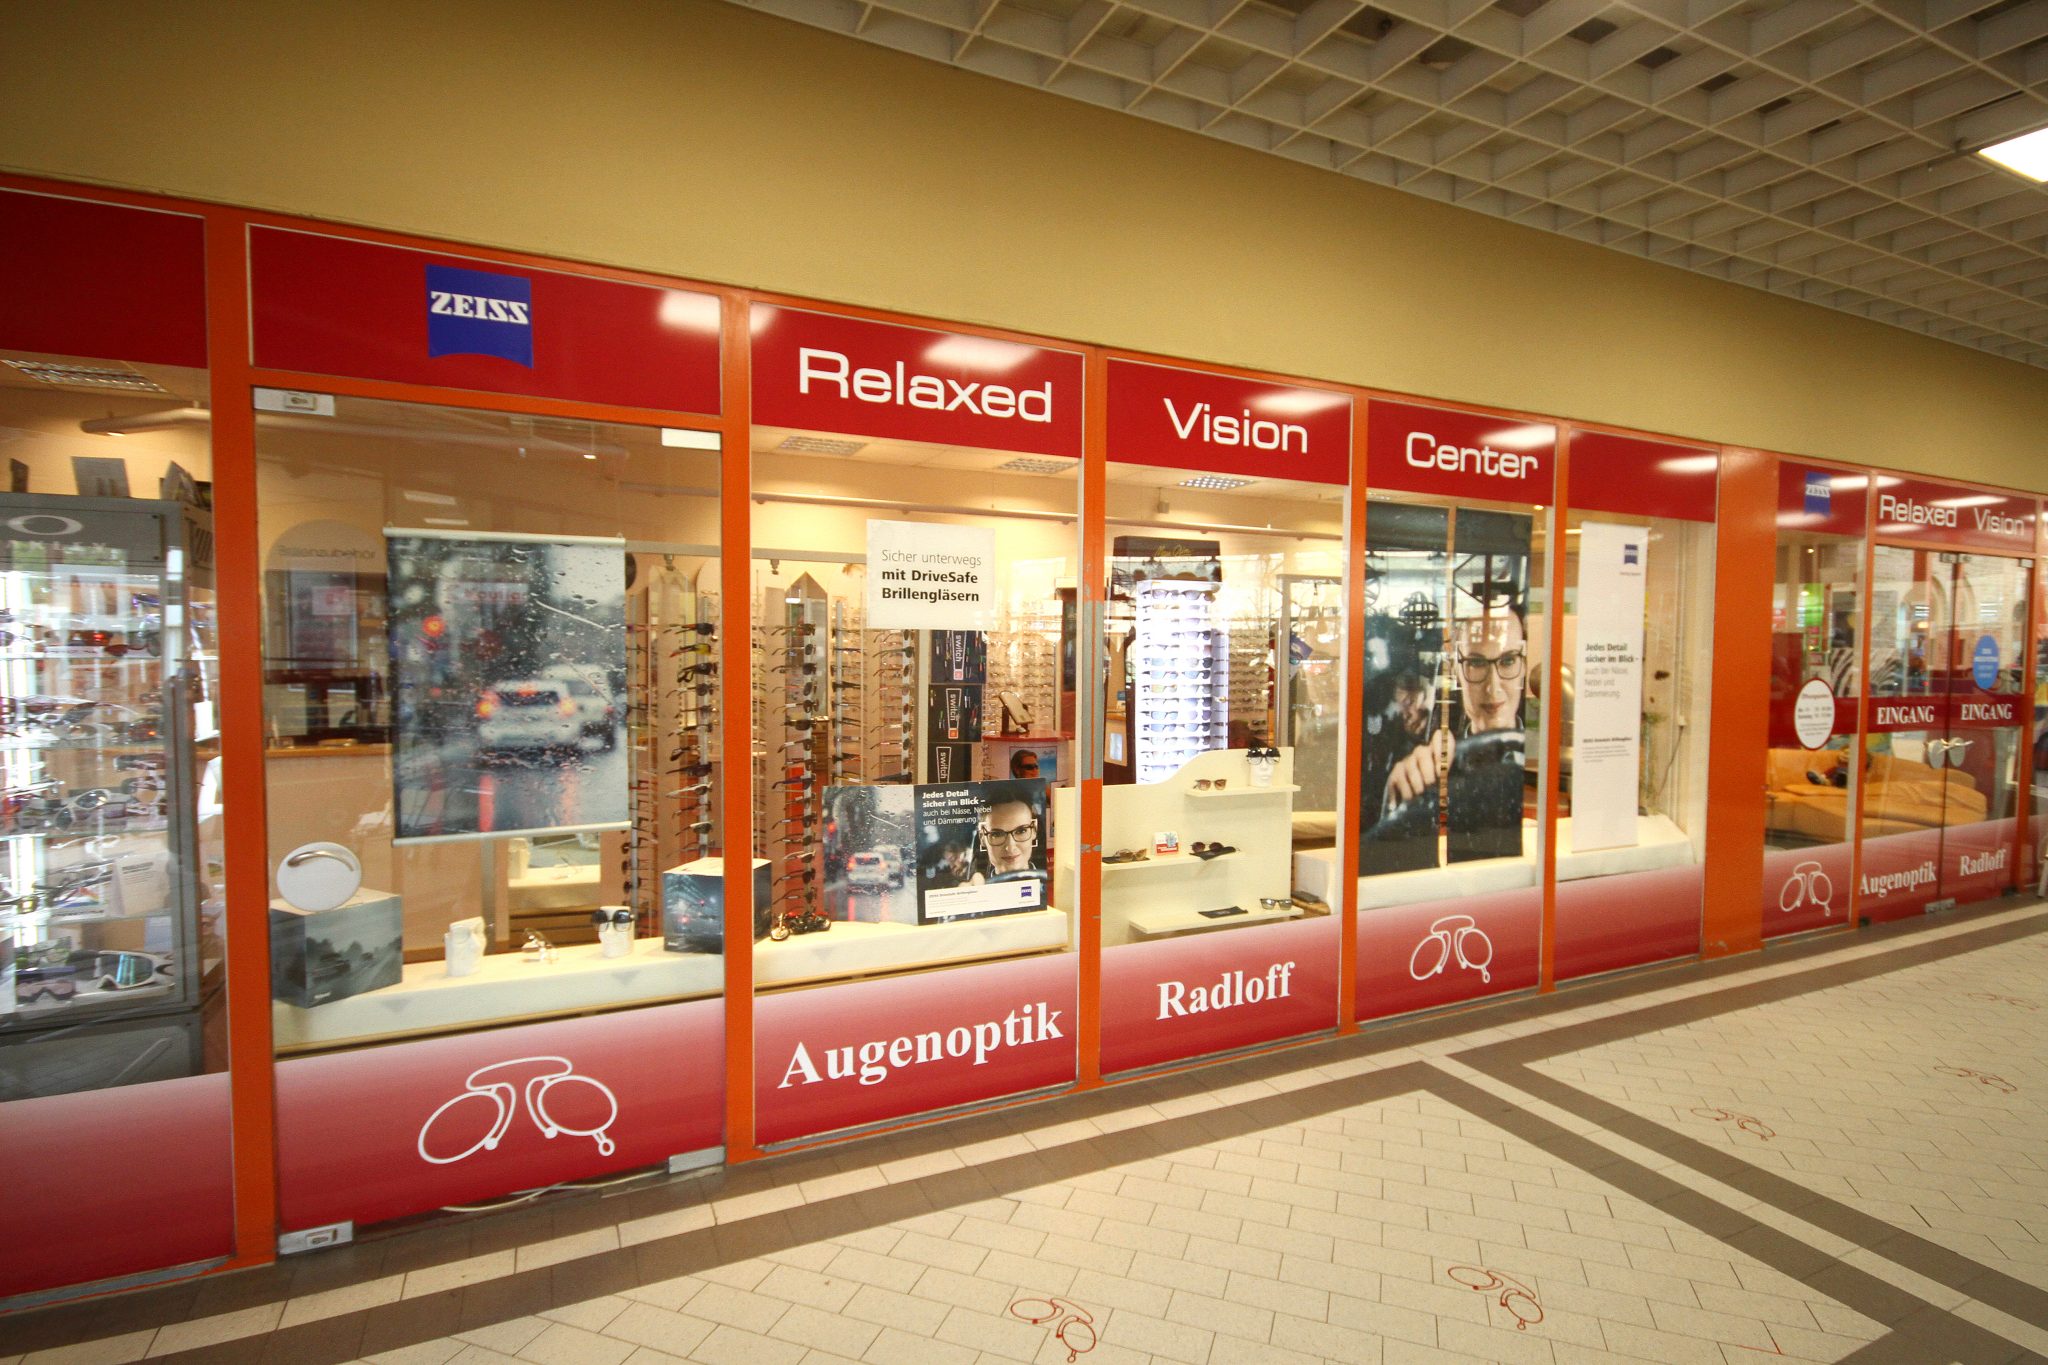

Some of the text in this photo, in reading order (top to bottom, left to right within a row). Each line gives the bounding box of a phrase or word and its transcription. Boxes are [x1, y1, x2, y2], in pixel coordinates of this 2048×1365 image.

[430, 290, 529, 325] ZEISS
[799, 347, 1539, 480] Relaxed Vision Center
[1879, 494, 1957, 528] Relaxed
[1974, 507, 2025, 536] Vision
[881, 549, 982, 569] Sicher unterwegs
[881, 568, 979, 584] mit DriveSafe
[881, 587, 980, 604] Brillengläsern
[954, 634, 963, 662] switch
[1607, 642, 1628, 651] Detail
[949, 693, 958, 721] switch
[1876, 703, 2013, 725] EINGANG EINGANG
[940, 751, 948, 779] switch
[922, 789, 969, 799] Jedes Detail
[922, 800, 946, 808] sicher
[959, 796, 979, 806] Blick
[923, 809, 939, 817] auch
[940, 808, 950, 816] bei
[974, 805, 992, 814] Nebel
[923, 818, 936, 826] und
[1859, 848, 2006, 898] Augenoptik Radloff
[777, 961, 1296, 1090] Augenoptik Radloff
